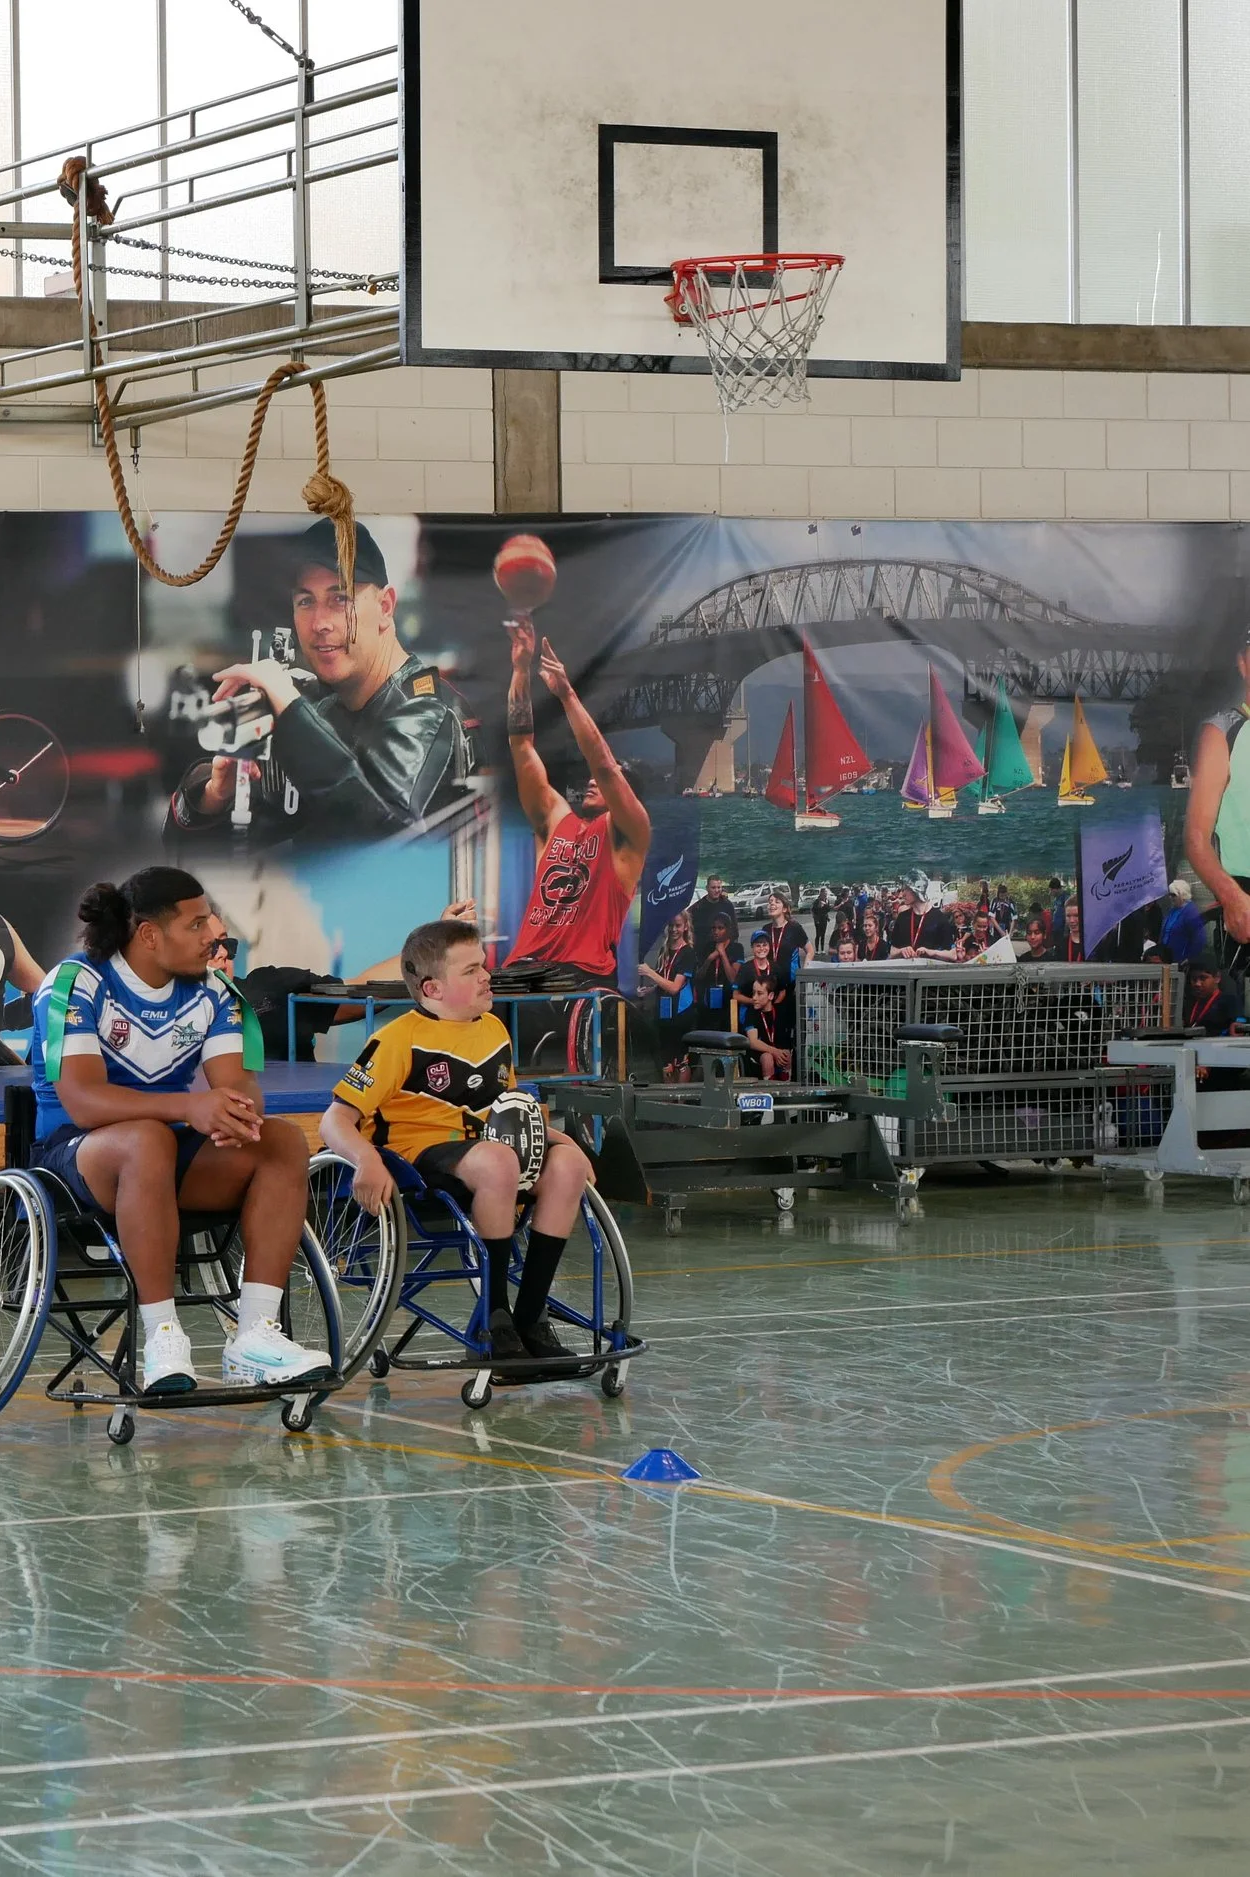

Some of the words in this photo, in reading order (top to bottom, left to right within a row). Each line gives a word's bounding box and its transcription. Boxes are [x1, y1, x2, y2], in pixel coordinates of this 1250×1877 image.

[840, 755, 856, 766] NZL
[140, 1010, 168, 1019] EMU
[114, 1020, 128, 1030] QLD
[430, 1064, 446, 1075] QLD
[741, 1098, 768, 1108] WB01
[523, 1103, 545, 1182] STEEDEN
